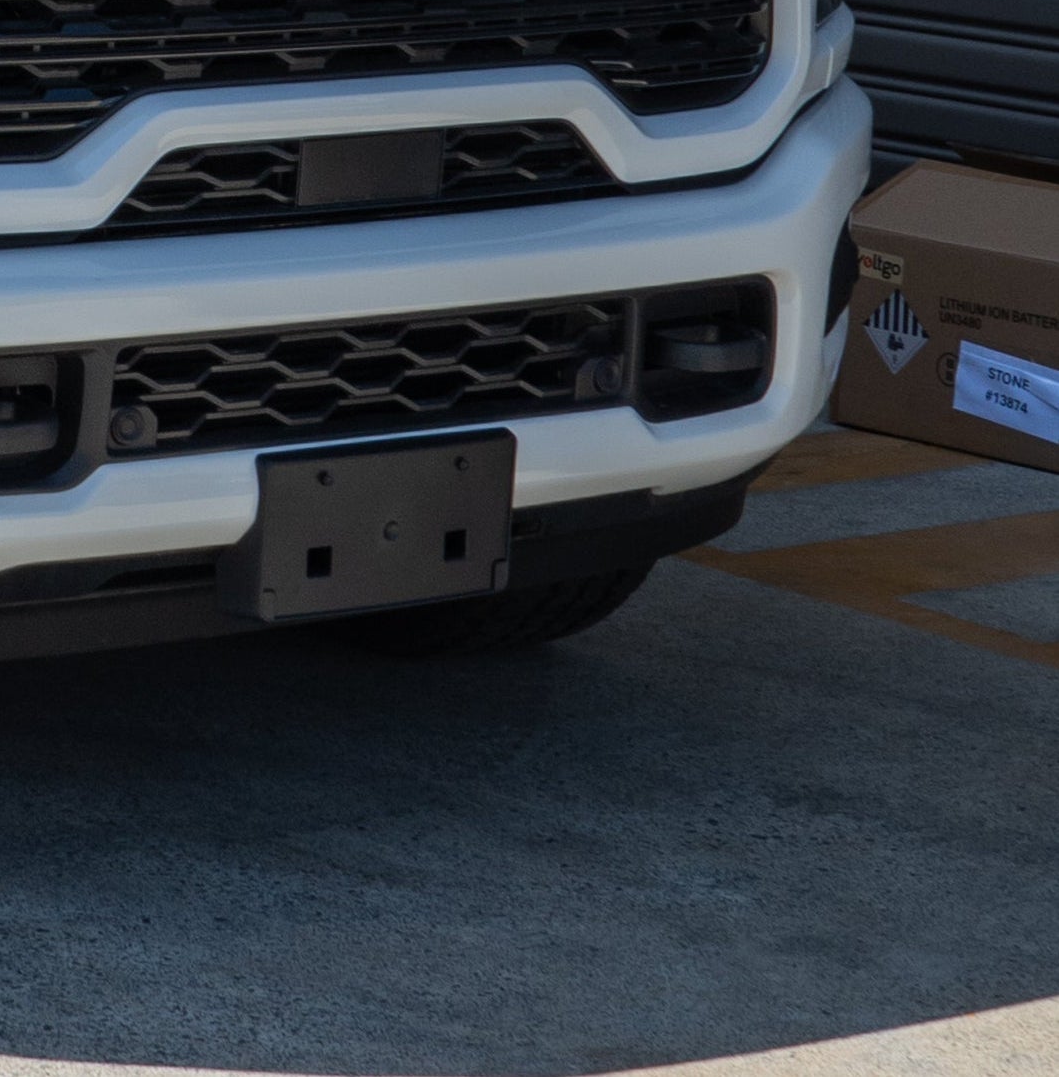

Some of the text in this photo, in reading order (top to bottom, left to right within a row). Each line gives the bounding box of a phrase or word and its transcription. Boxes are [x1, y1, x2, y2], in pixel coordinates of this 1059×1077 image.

[939, 296, 987, 316] LITHIUM
[989, 306, 1010, 321] ION
[988, 367, 1031, 391] STONE
[985, 390, 1029, 414] #13874
